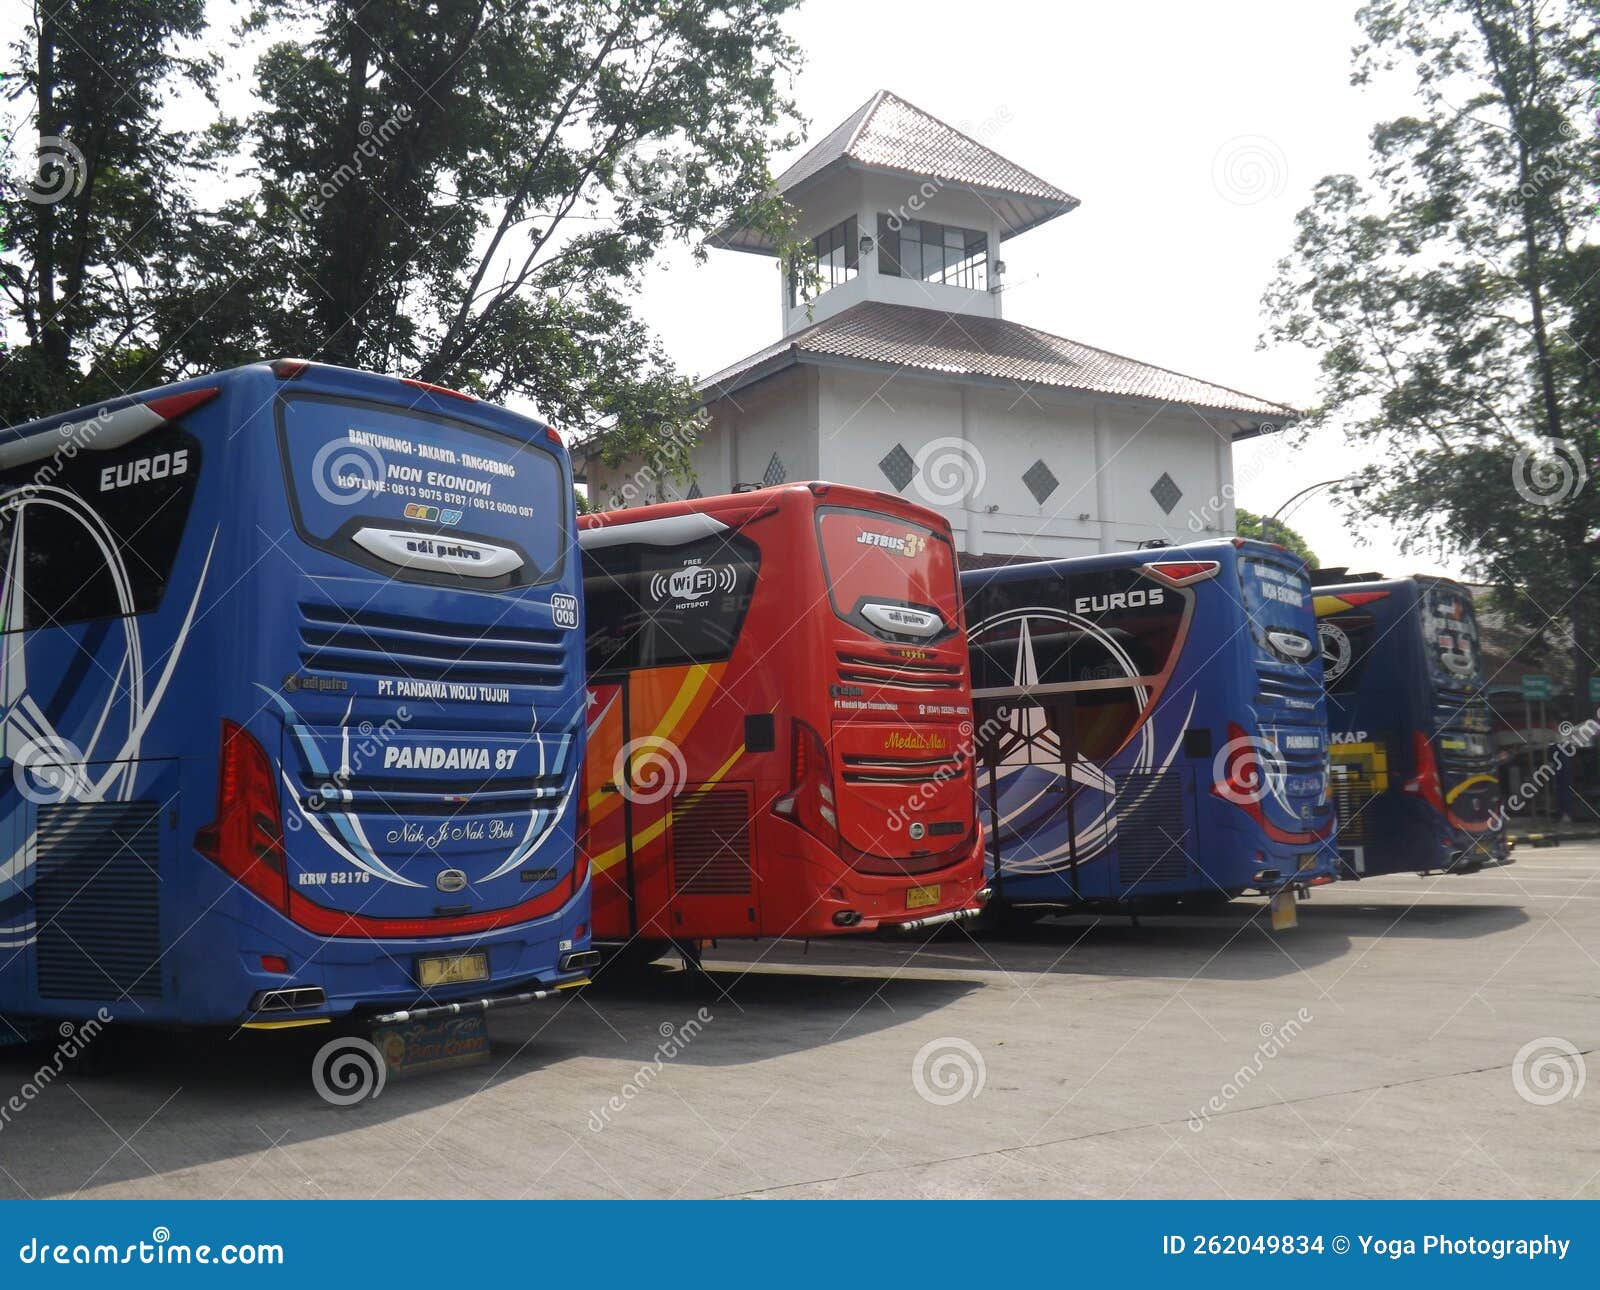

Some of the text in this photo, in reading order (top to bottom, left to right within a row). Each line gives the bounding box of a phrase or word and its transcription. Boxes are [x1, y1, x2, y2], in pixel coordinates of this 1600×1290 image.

[348, 429, 412, 455] BANYUWANGI
[418, 443, 456, 465] JAKARTA
[462, 453, 516, 478] TANGGERANG
[388, 464, 491, 496] NON EKONOMI
[337, 475, 390, 493] HOTLINE:
[391, 484, 416, 497] 0813
[418, 488, 442, 502] 9075
[473, 498, 495, 512] 0812
[683, 558, 702, 566] FREE
[554, 597, 576, 610] PDW
[675, 600, 710, 610] HOTSPOT
[556, 609, 575, 624] 008
[378, 680, 510, 703] PT. PANDAWA WOLU TUJUH
[1329, 731, 1368, 744] KAP
[384, 747, 518, 770] PANDAWA 87
[387, 823, 424, 842] Nak
[451, 820, 485, 840] Nak
[299, 872, 369, 885] KRW 52176
